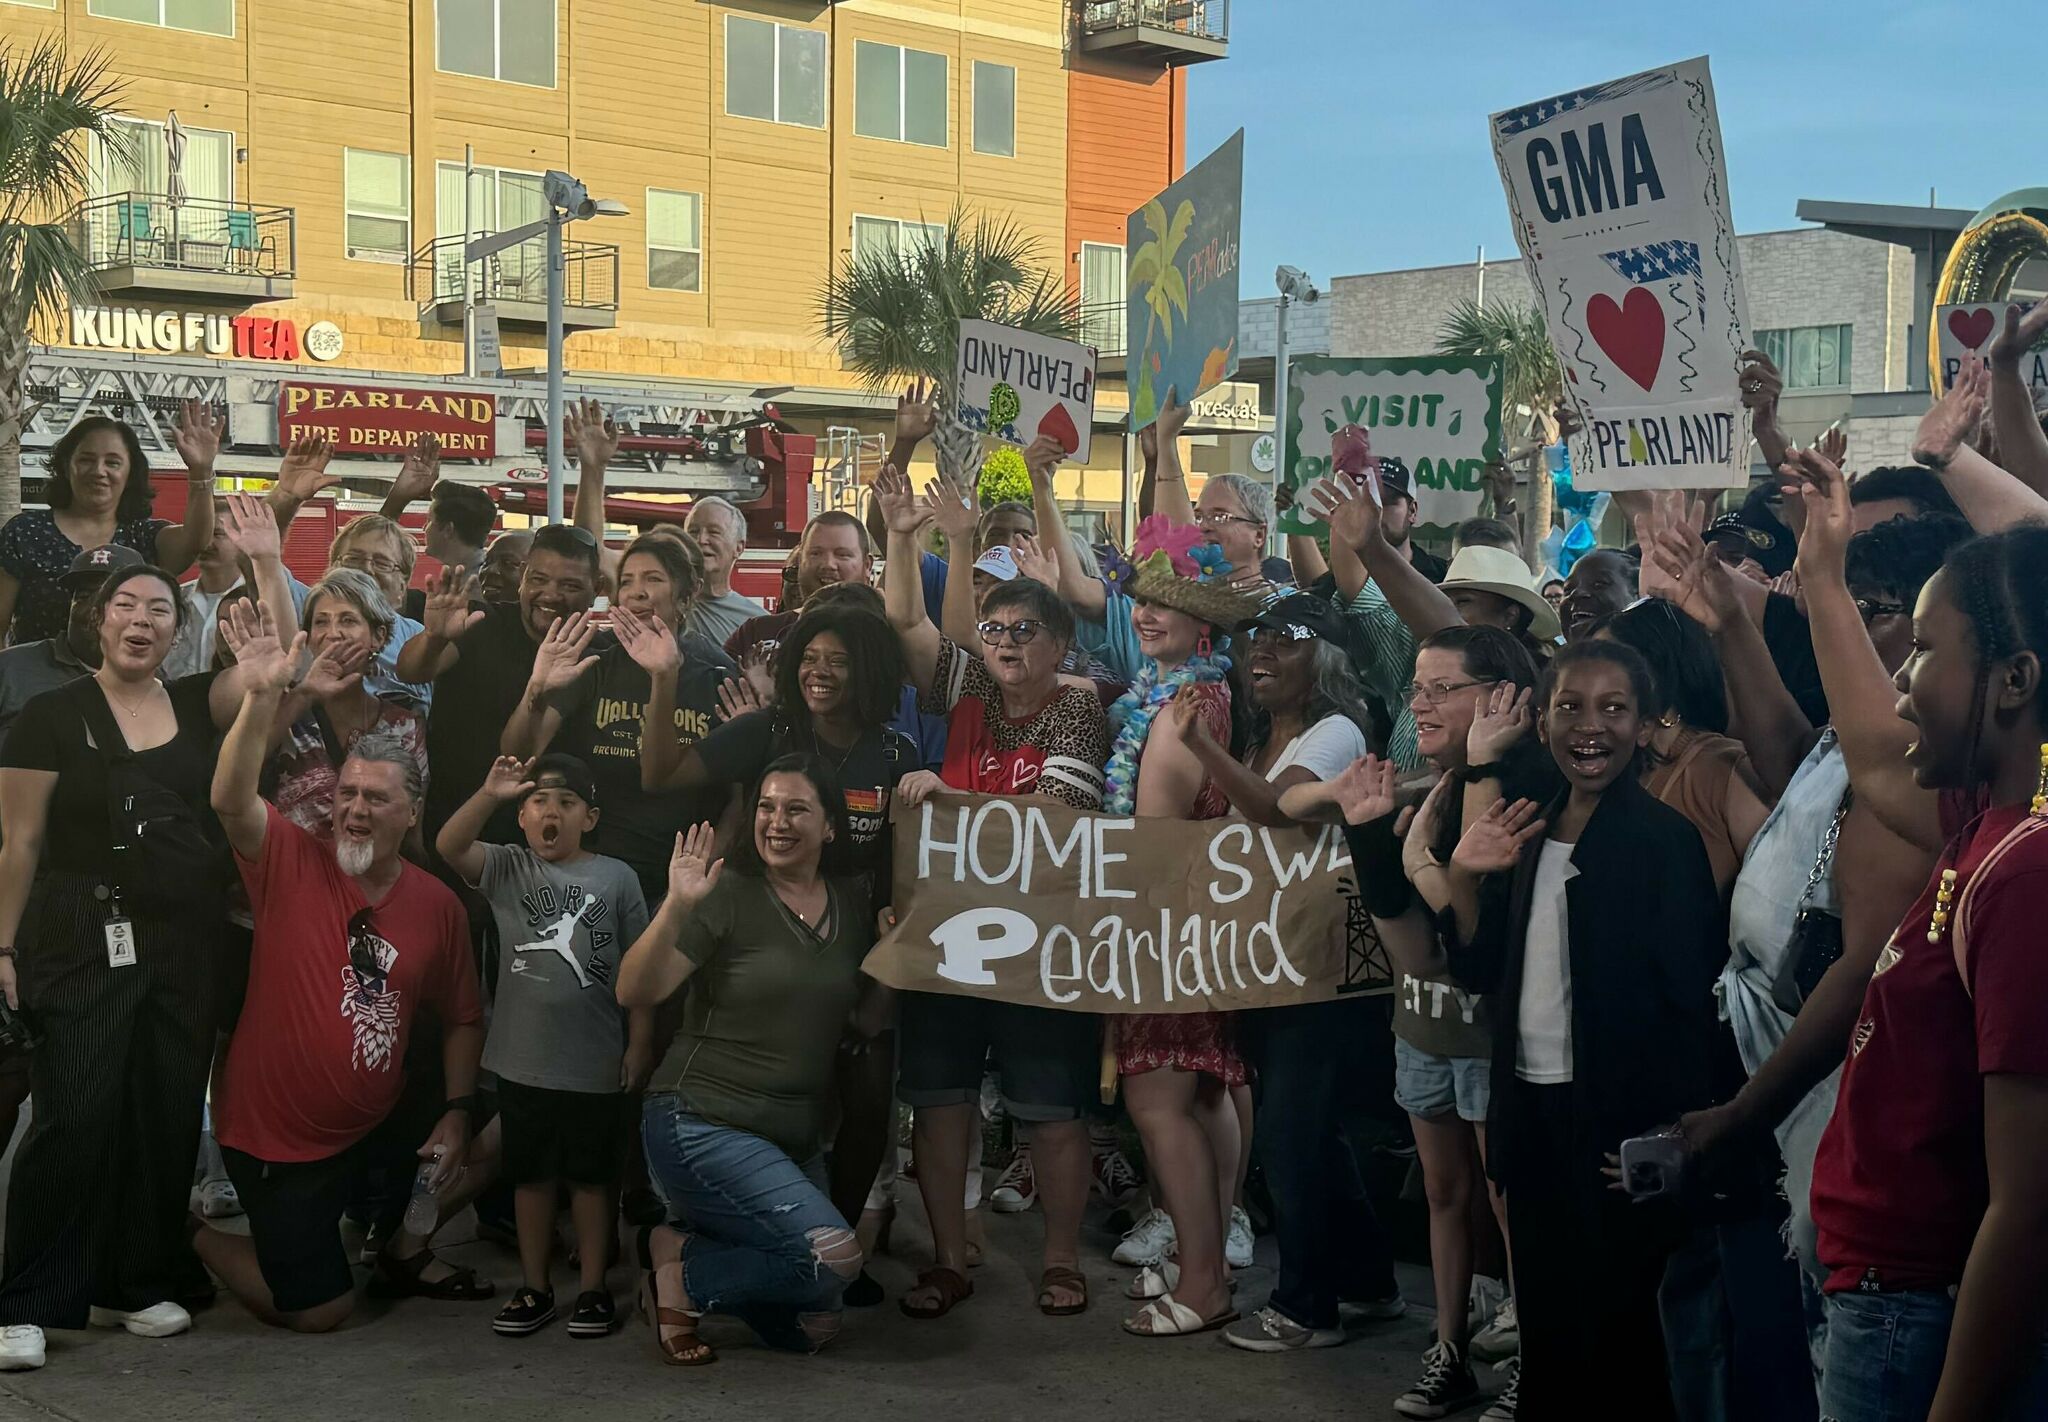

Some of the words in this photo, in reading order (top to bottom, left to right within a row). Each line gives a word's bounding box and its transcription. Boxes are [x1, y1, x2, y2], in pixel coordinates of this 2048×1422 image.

[1526, 113, 1666, 224] GMA
[233, 315, 300, 361] TEA
[964, 337, 1088, 405] PEARLAND
[285, 387, 493, 424] PEARLAND
[1191, 398, 1259, 420] ncesca's
[1341, 394, 1444, 428] VISIT
[290, 424, 340, 443] FIRE
[349, 427, 489, 451] DEPARMENT
[593, 745, 636, 758] BREWING
[917, 800, 1137, 899] HOME
[1208, 823, 1354, 904] SWE
[522, 884, 615, 988] JORDAN
[928, 890, 1307, 1005] Pearland
